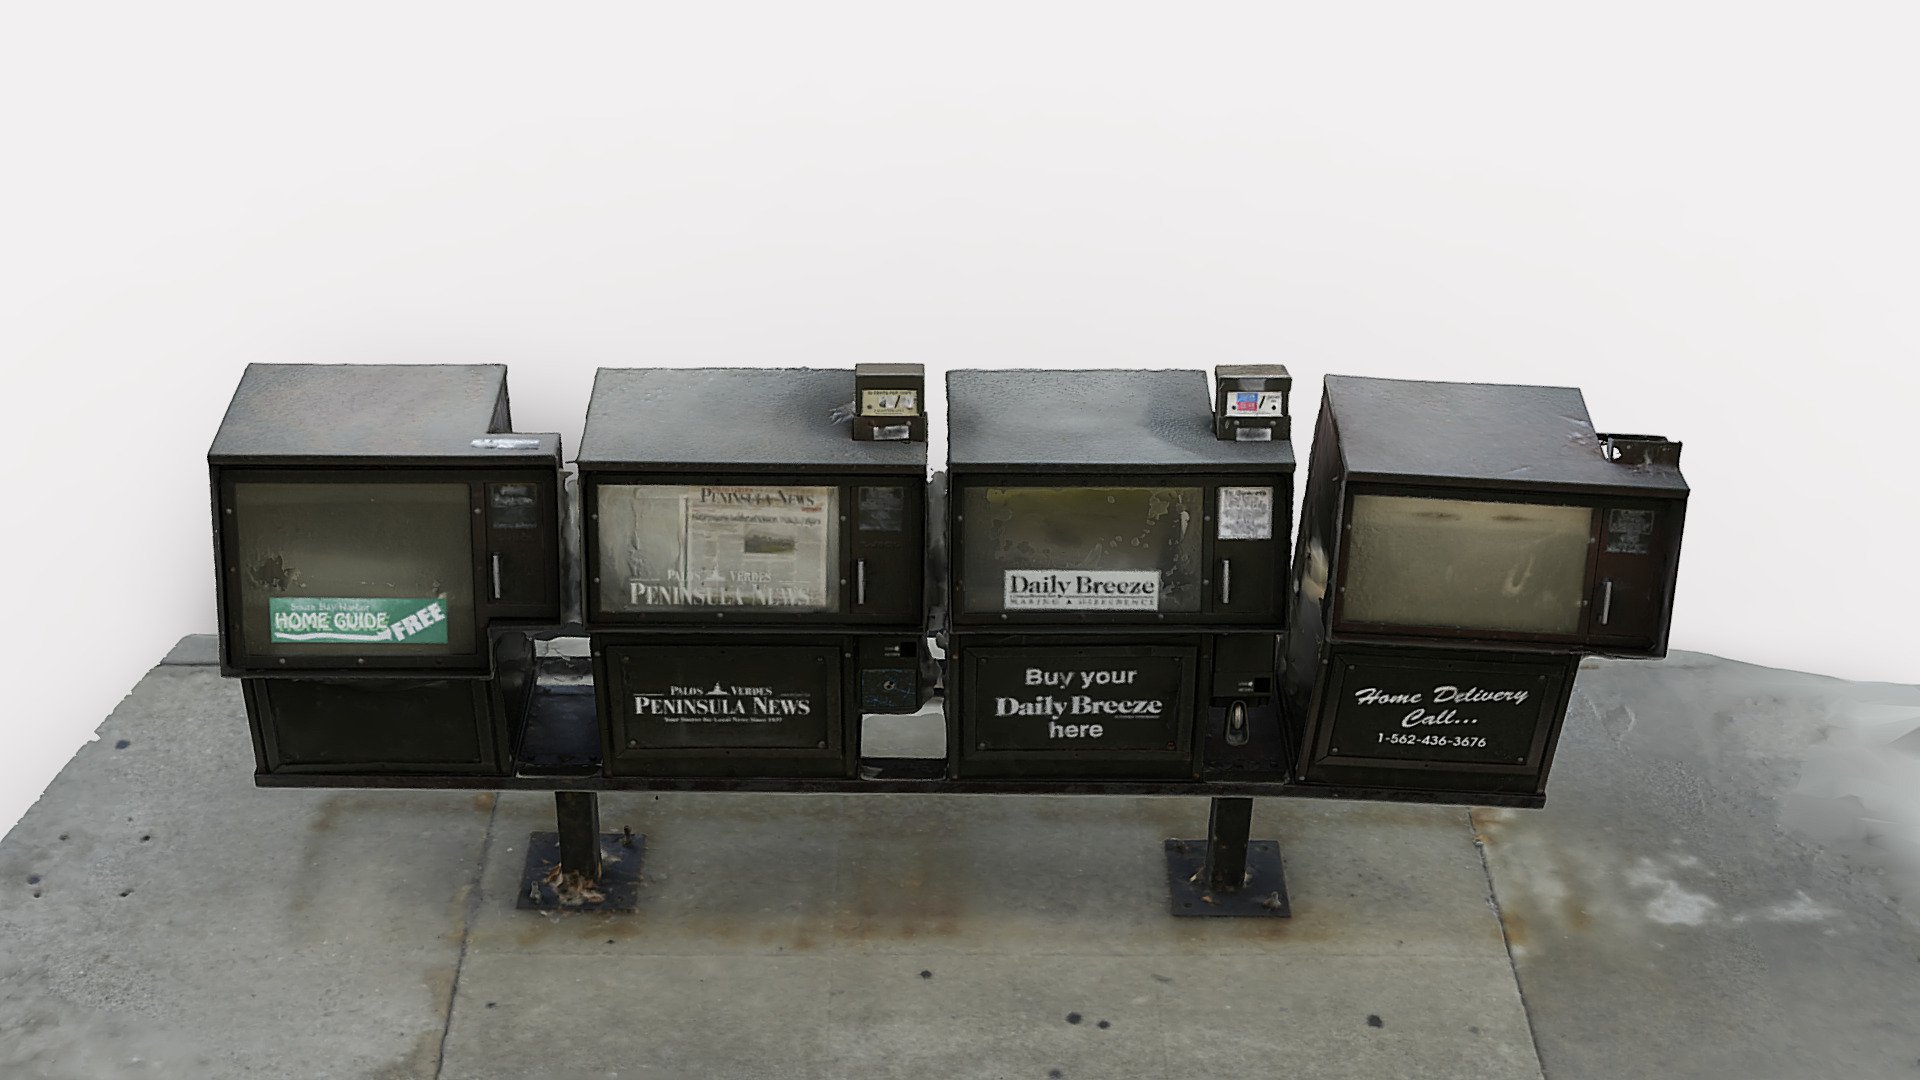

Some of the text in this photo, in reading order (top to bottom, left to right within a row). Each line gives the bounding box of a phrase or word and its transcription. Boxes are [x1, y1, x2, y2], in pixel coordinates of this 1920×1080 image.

[629, 582, 744, 605] PENINSULA
[1010, 574, 1155, 595] Daily Breeze
[275, 612, 390, 631] HOME GUIDE
[390, 602, 446, 642] FREE
[1025, 668, 1138, 689] Buy your
[670, 685, 773, 696] PALOS VERDES
[1355, 685, 1530, 706] Home Delivery
[634, 696, 811, 716] PENINSULA NEWS
[995, 695, 1163, 720] Daily Breeze
[1049, 721, 1104, 739] here
[1377, 732, 1487, 748] 1-562-436-3676
